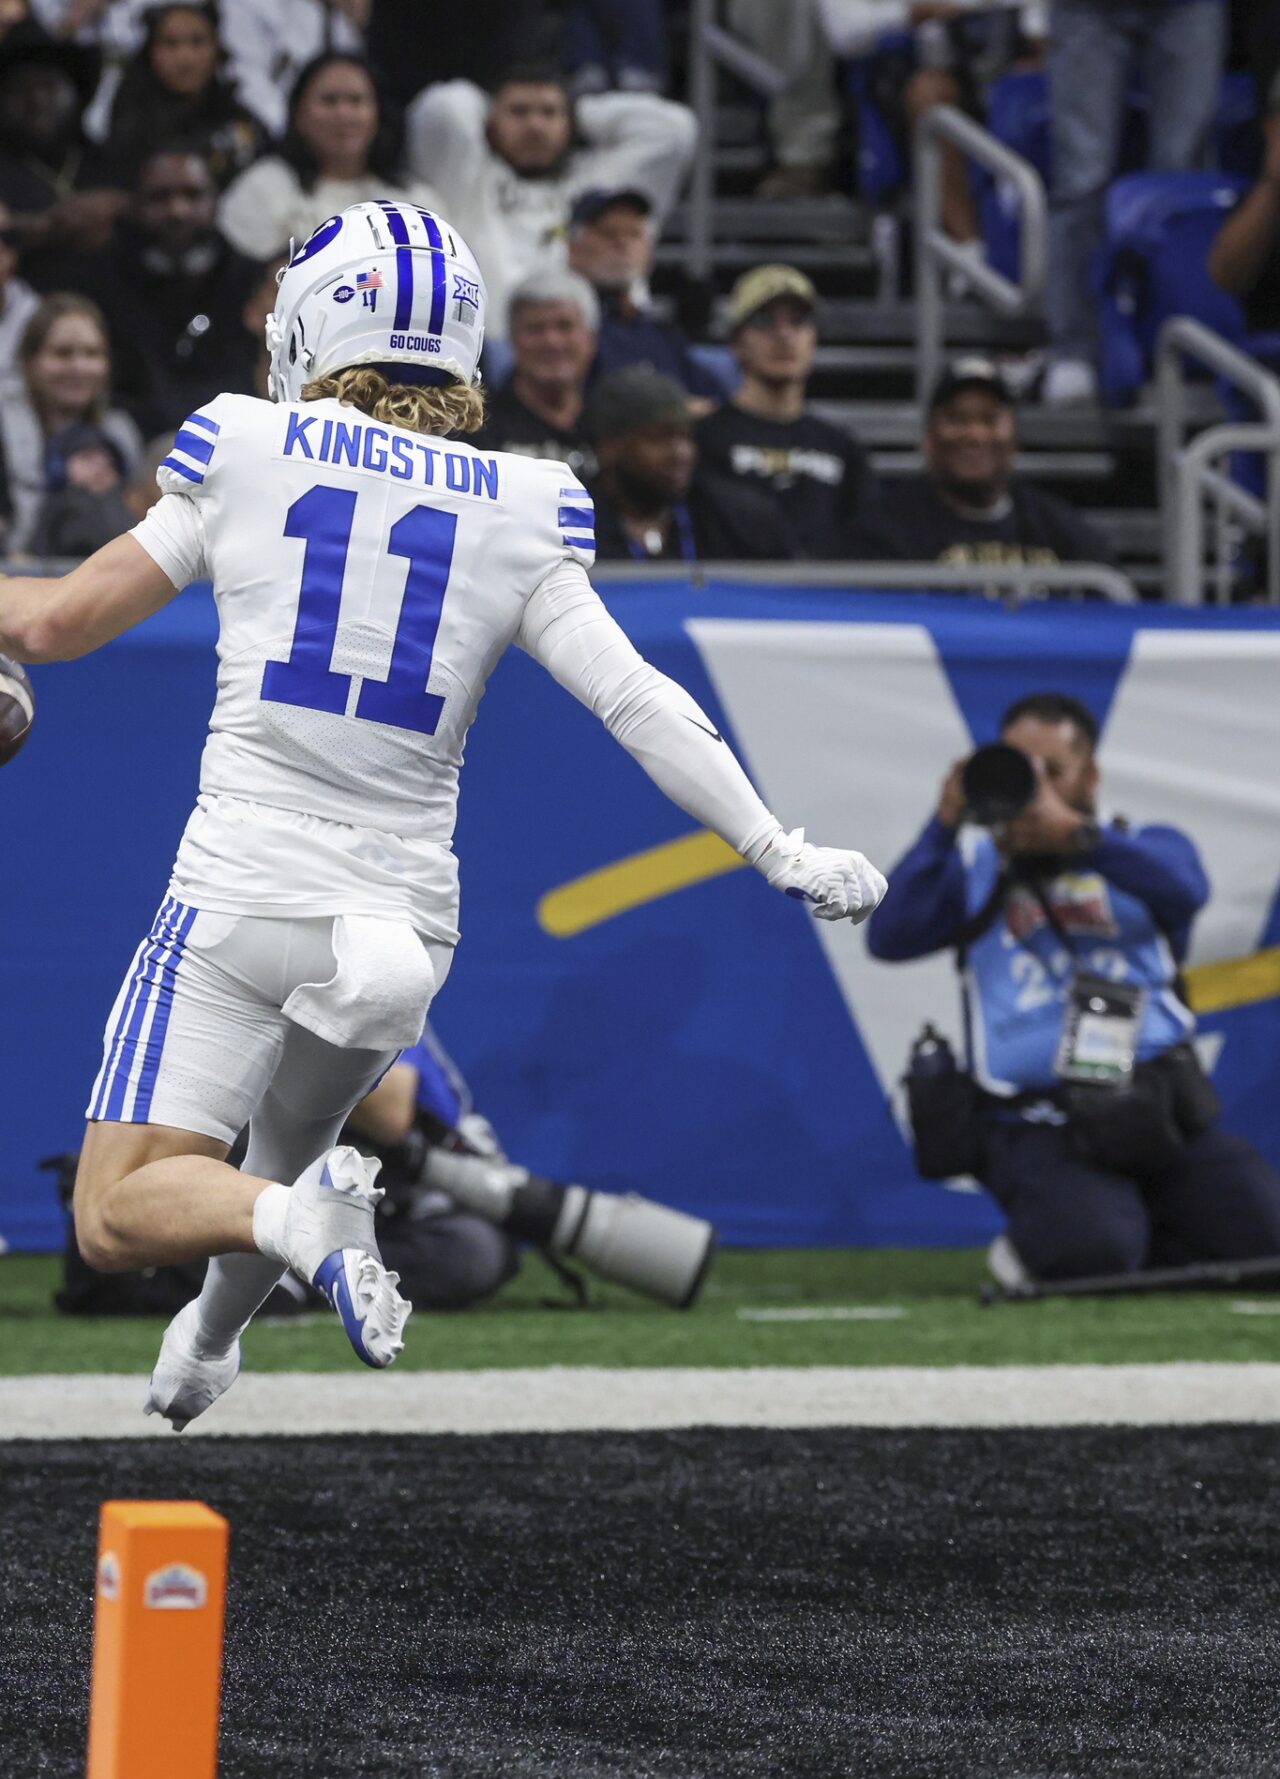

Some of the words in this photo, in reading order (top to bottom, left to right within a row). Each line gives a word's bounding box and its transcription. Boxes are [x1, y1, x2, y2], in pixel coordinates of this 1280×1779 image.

[390, 334, 405, 349] GO
[406, 336, 441, 353] COUGS
[283, 411, 498, 500] KINGSTON
[260, 484, 458, 736] 11
